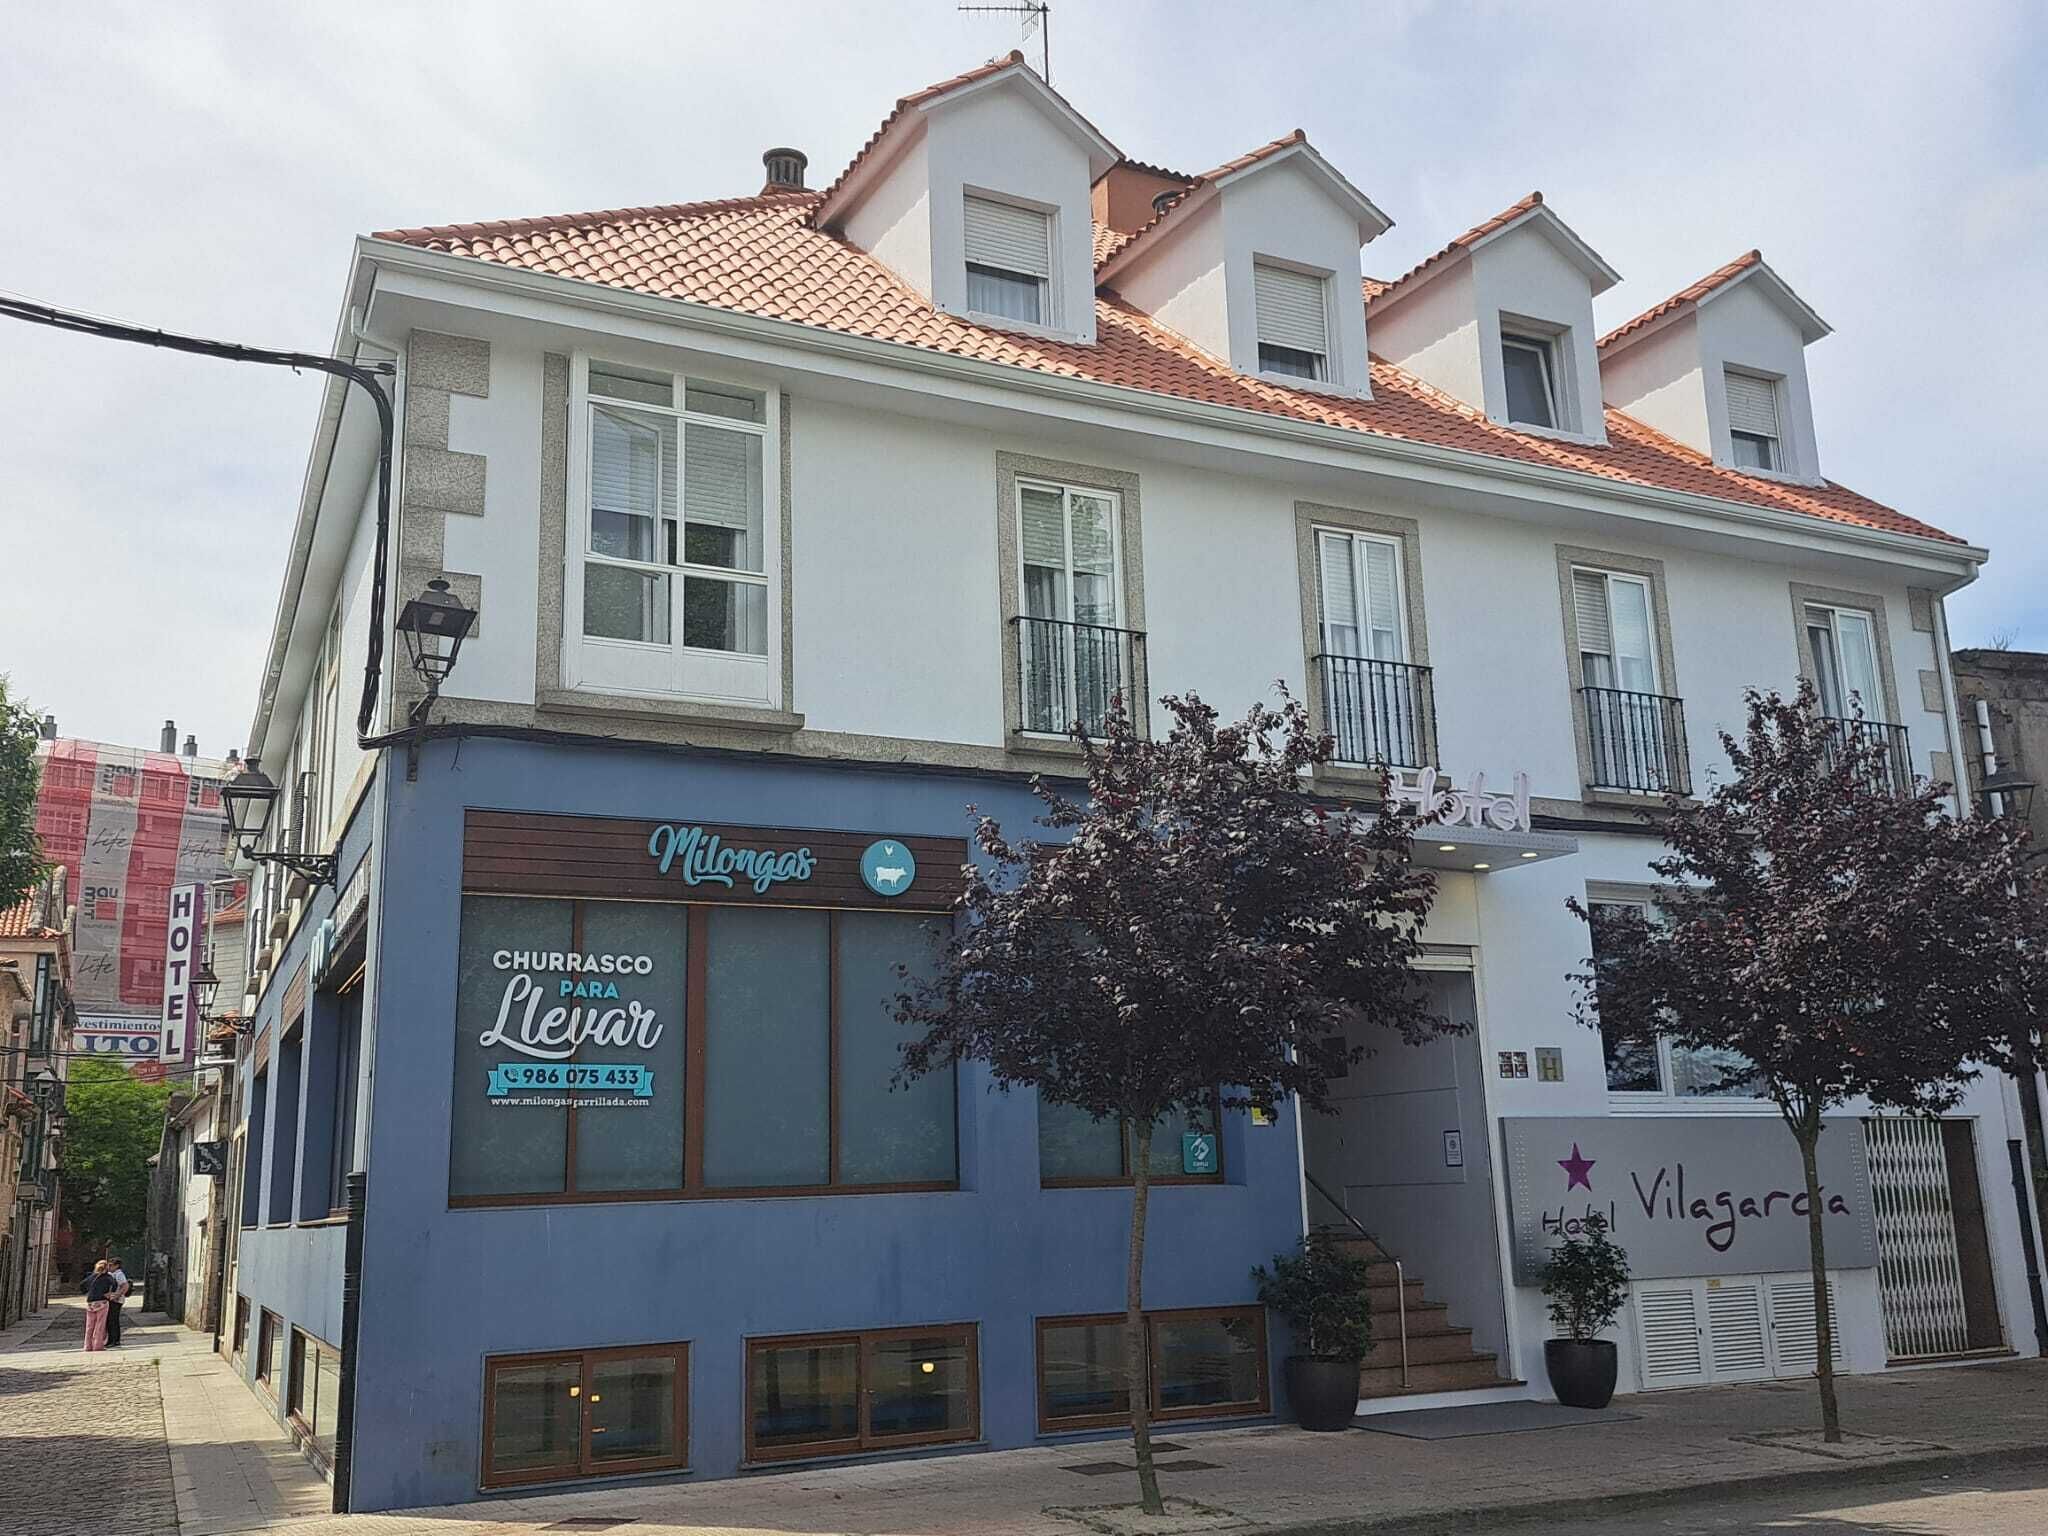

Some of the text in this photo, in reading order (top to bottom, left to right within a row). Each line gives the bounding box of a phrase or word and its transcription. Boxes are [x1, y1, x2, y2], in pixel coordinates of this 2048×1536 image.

[1386, 766, 1532, 833] Hotel
[648, 824, 818, 895] Milongas
[165, 892, 192, 1056] HOTEL
[493, 950, 653, 975] CHURRASCO
[559, 979, 619, 999] PARA
[479, 974, 664, 1060] Llevar
[523, 1068, 639, 1085] 986 075 433
